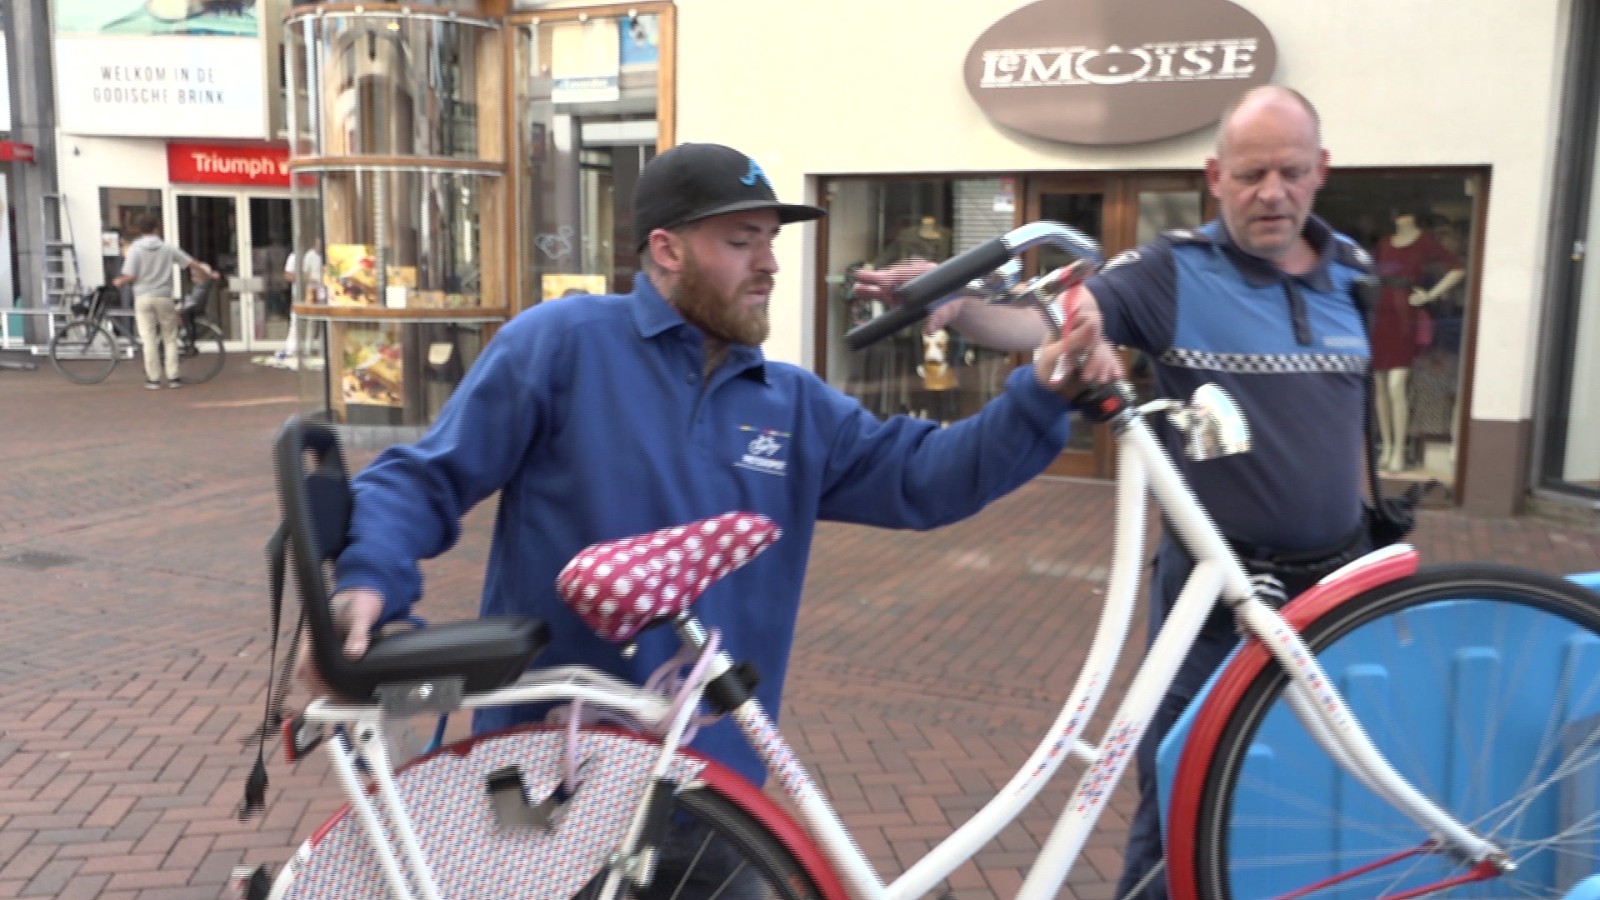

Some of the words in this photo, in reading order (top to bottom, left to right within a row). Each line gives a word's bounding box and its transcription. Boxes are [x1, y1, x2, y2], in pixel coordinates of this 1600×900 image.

[101, 65, 166, 82] WELKOM
[174, 67, 189, 82] IN
[196, 67, 214, 83] DE
[178, 88, 224, 105] BRINK
[191, 151, 275, 179] Triumph
